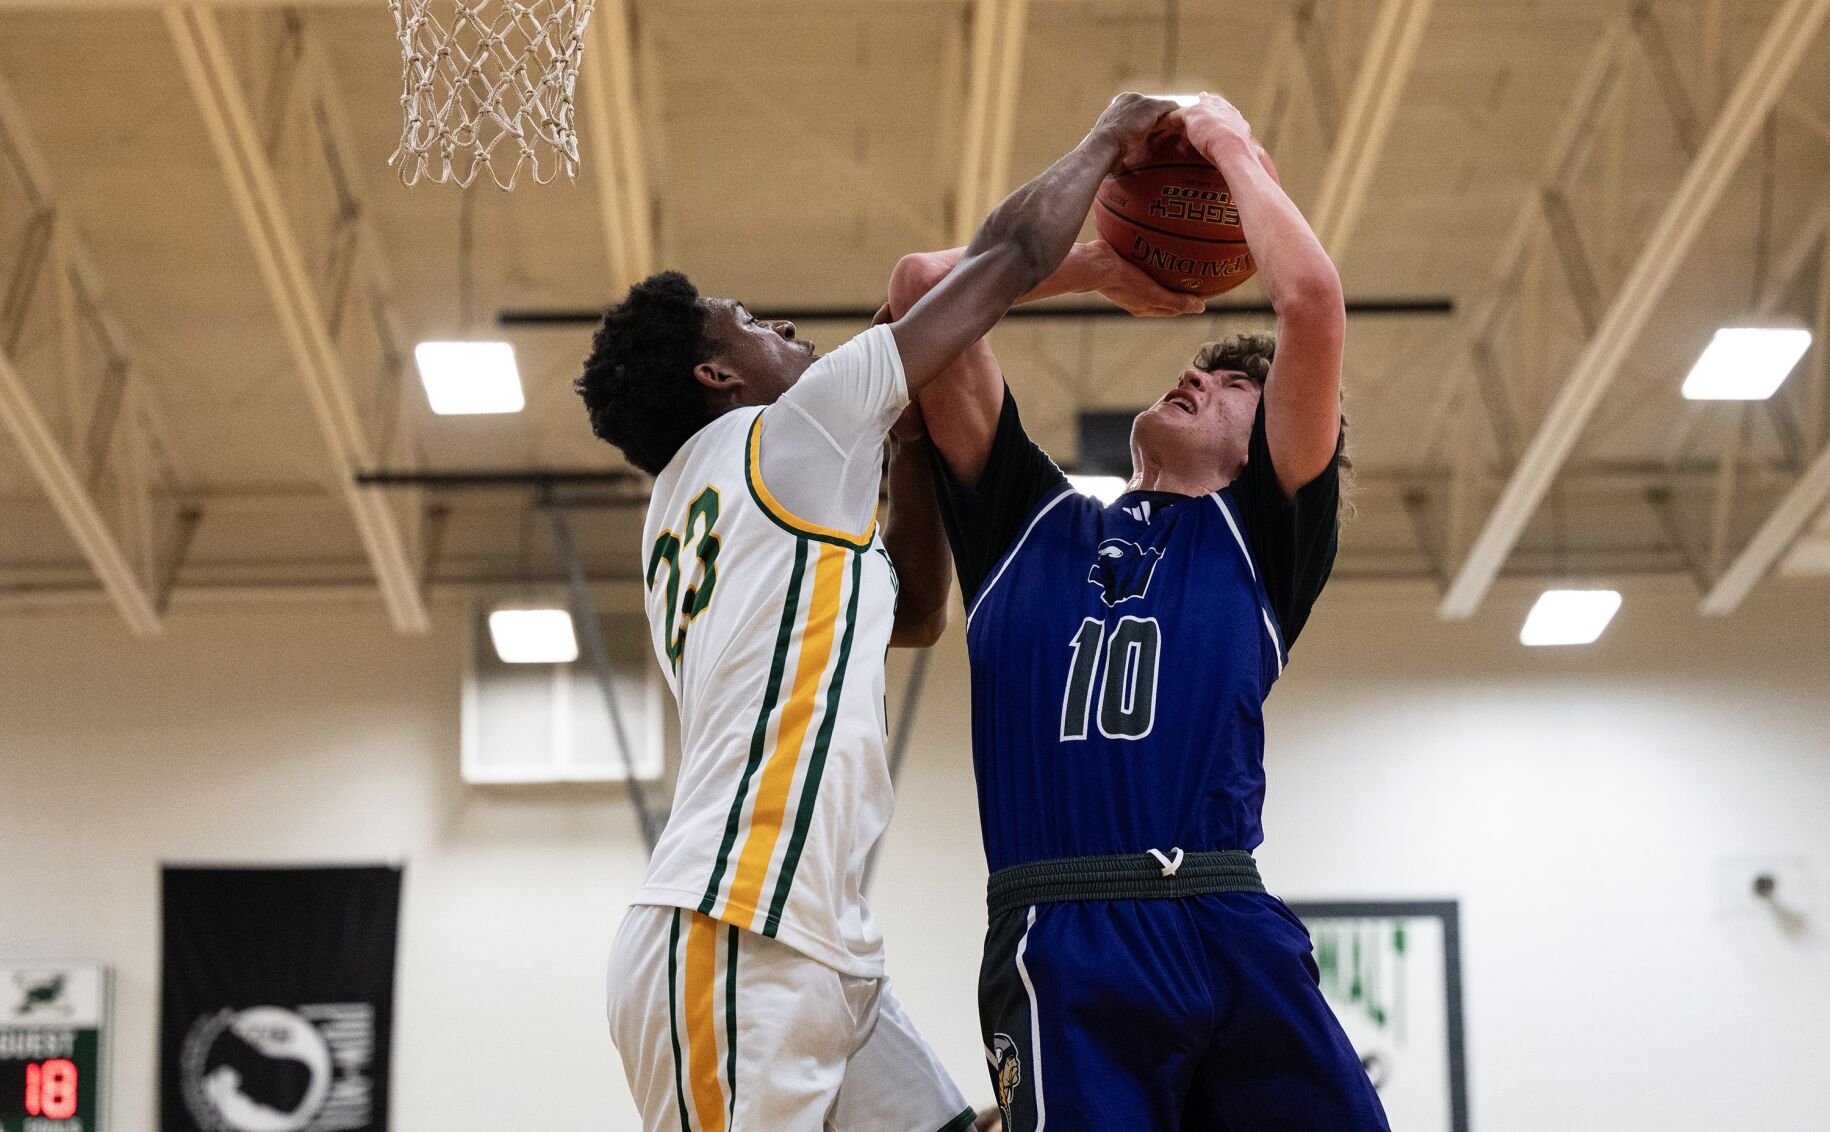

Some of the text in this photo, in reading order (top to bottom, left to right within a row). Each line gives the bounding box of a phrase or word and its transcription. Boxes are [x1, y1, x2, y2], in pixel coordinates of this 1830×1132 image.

[1150, 198, 1240, 227] EGACY
[1161, 185, 1236, 204] 1000
[647, 483, 721, 678] 23
[1060, 615, 1162, 742] 10
[25, 1058, 79, 1120] 18
